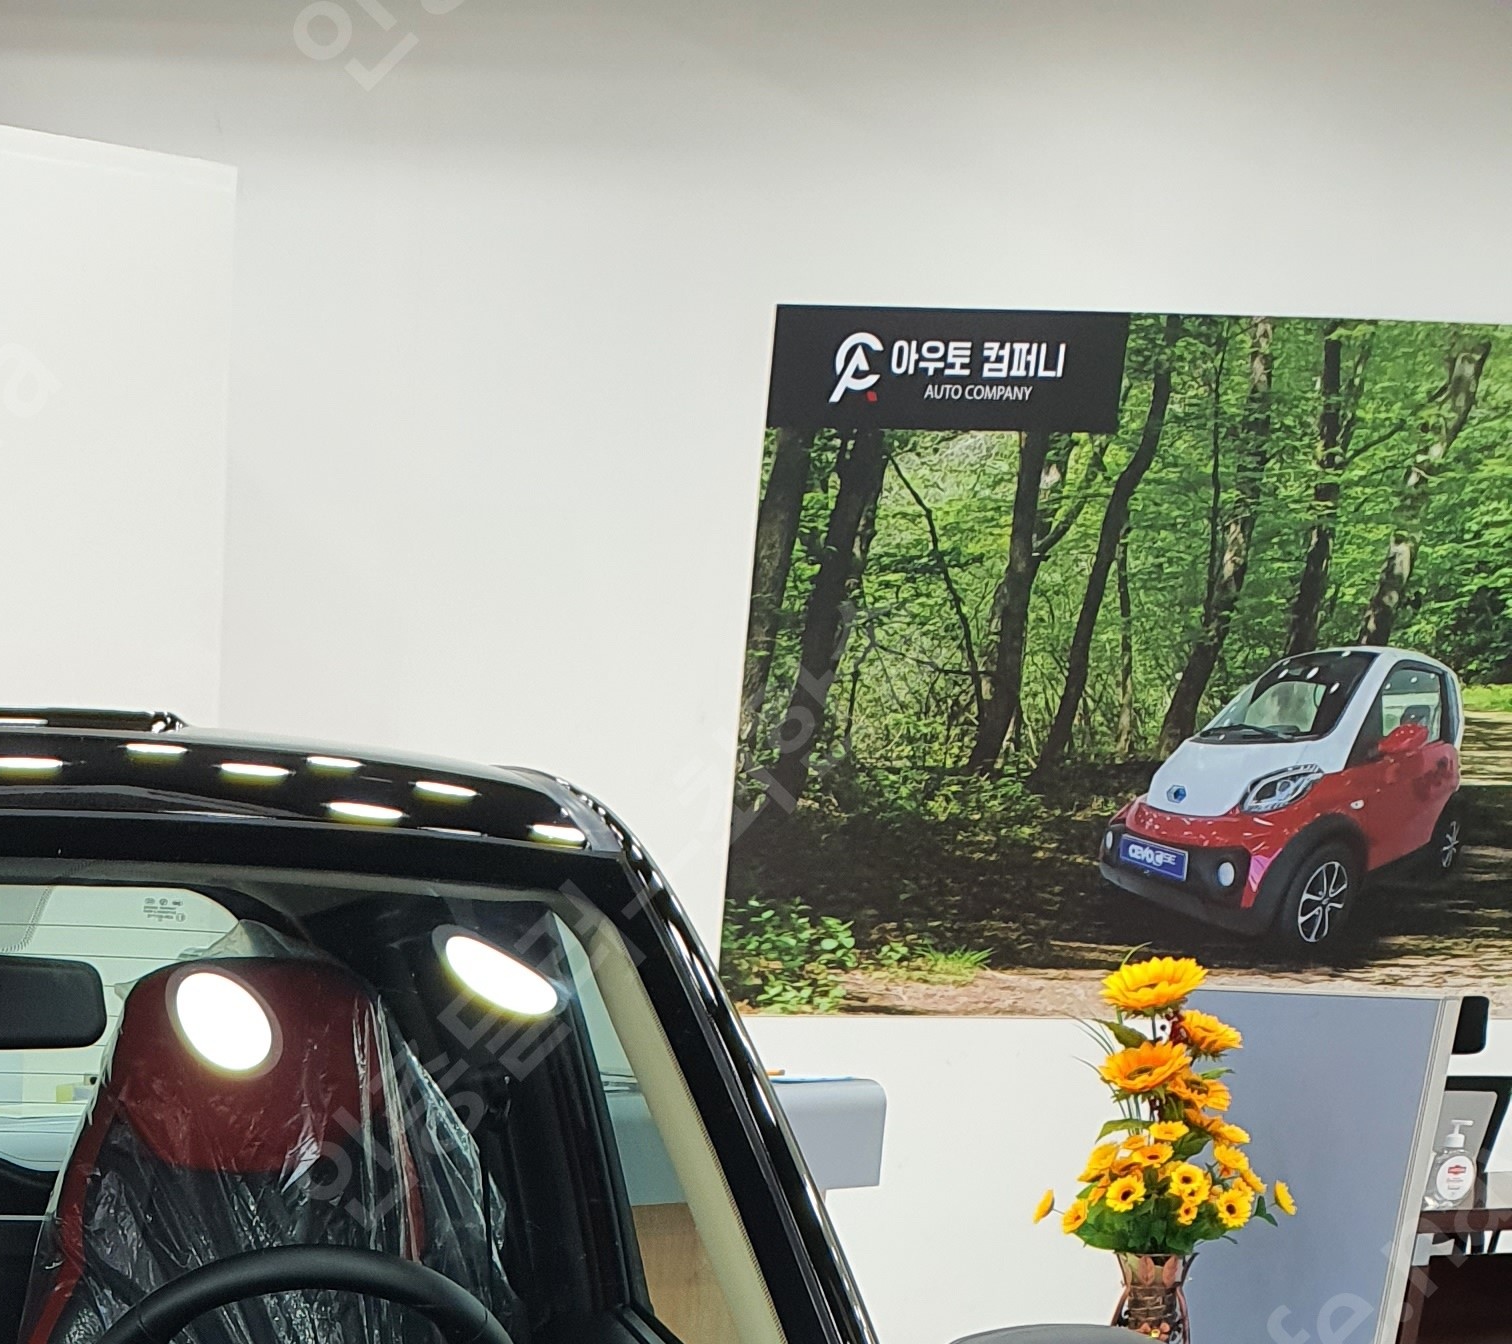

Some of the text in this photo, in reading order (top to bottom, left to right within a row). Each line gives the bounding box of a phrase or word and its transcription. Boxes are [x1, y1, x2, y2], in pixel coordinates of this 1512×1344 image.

[890, 339, 1067, 379] 아우토 컴퍼니
[923, 383, 1033, 402] AUTO COMPANY
